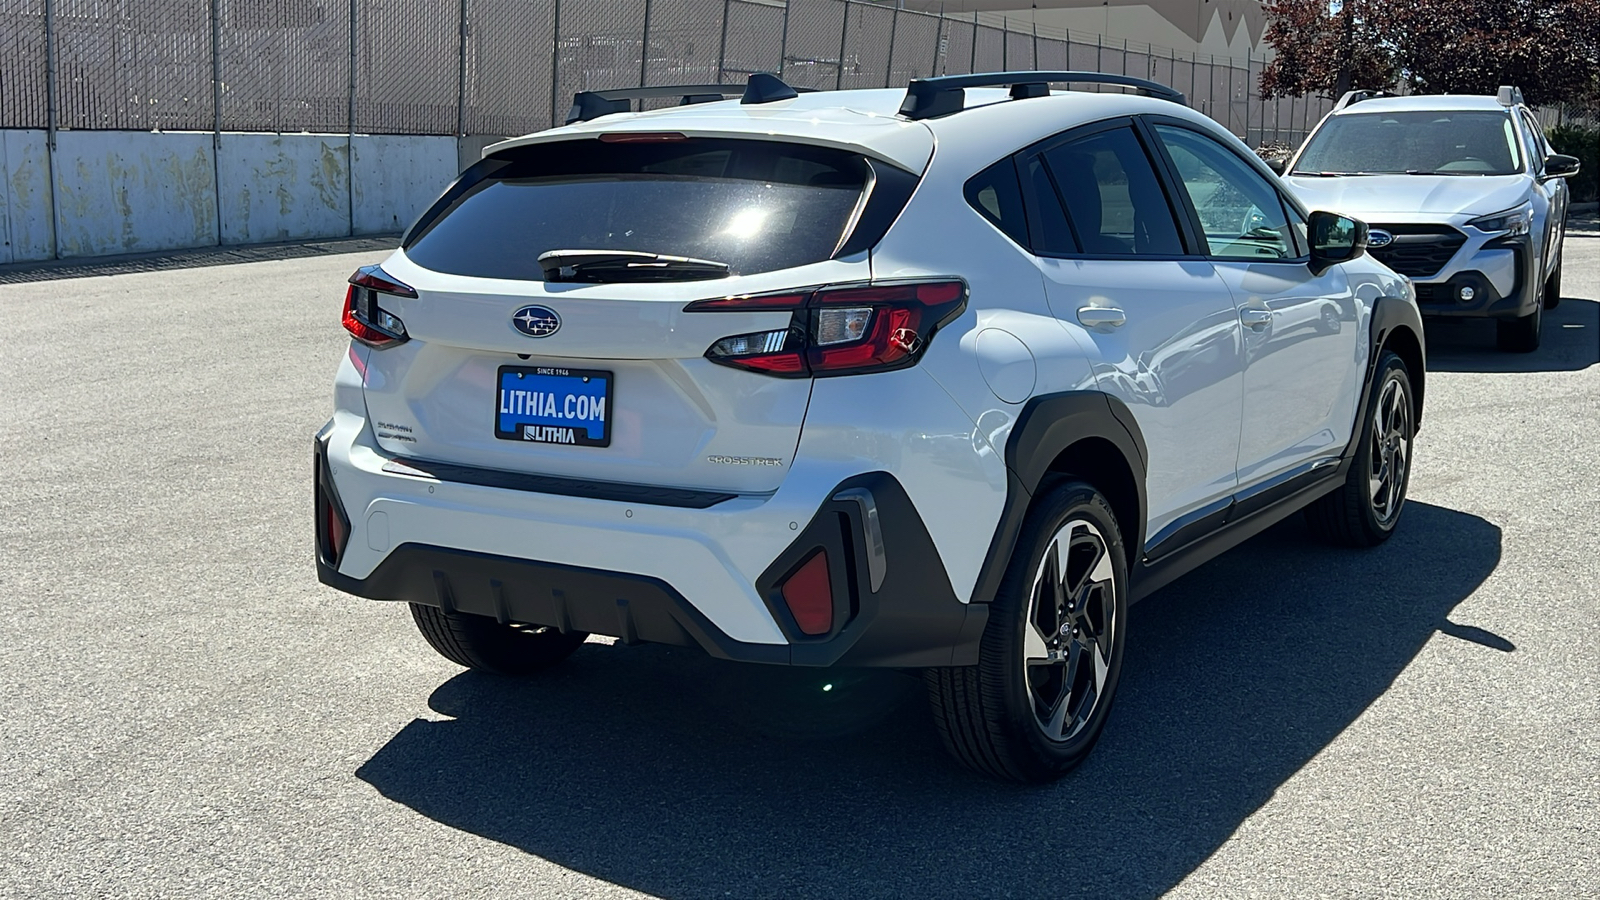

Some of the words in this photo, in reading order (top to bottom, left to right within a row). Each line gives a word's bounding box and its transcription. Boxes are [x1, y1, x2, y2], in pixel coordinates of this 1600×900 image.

[537, 367, 555, 375] SINCE
[556, 368, 569, 376] 1946
[500, 389, 606, 422] LITHIA.COM
[535, 426, 576, 444] LITHIA
[707, 454, 783, 467] CROSSTREK
